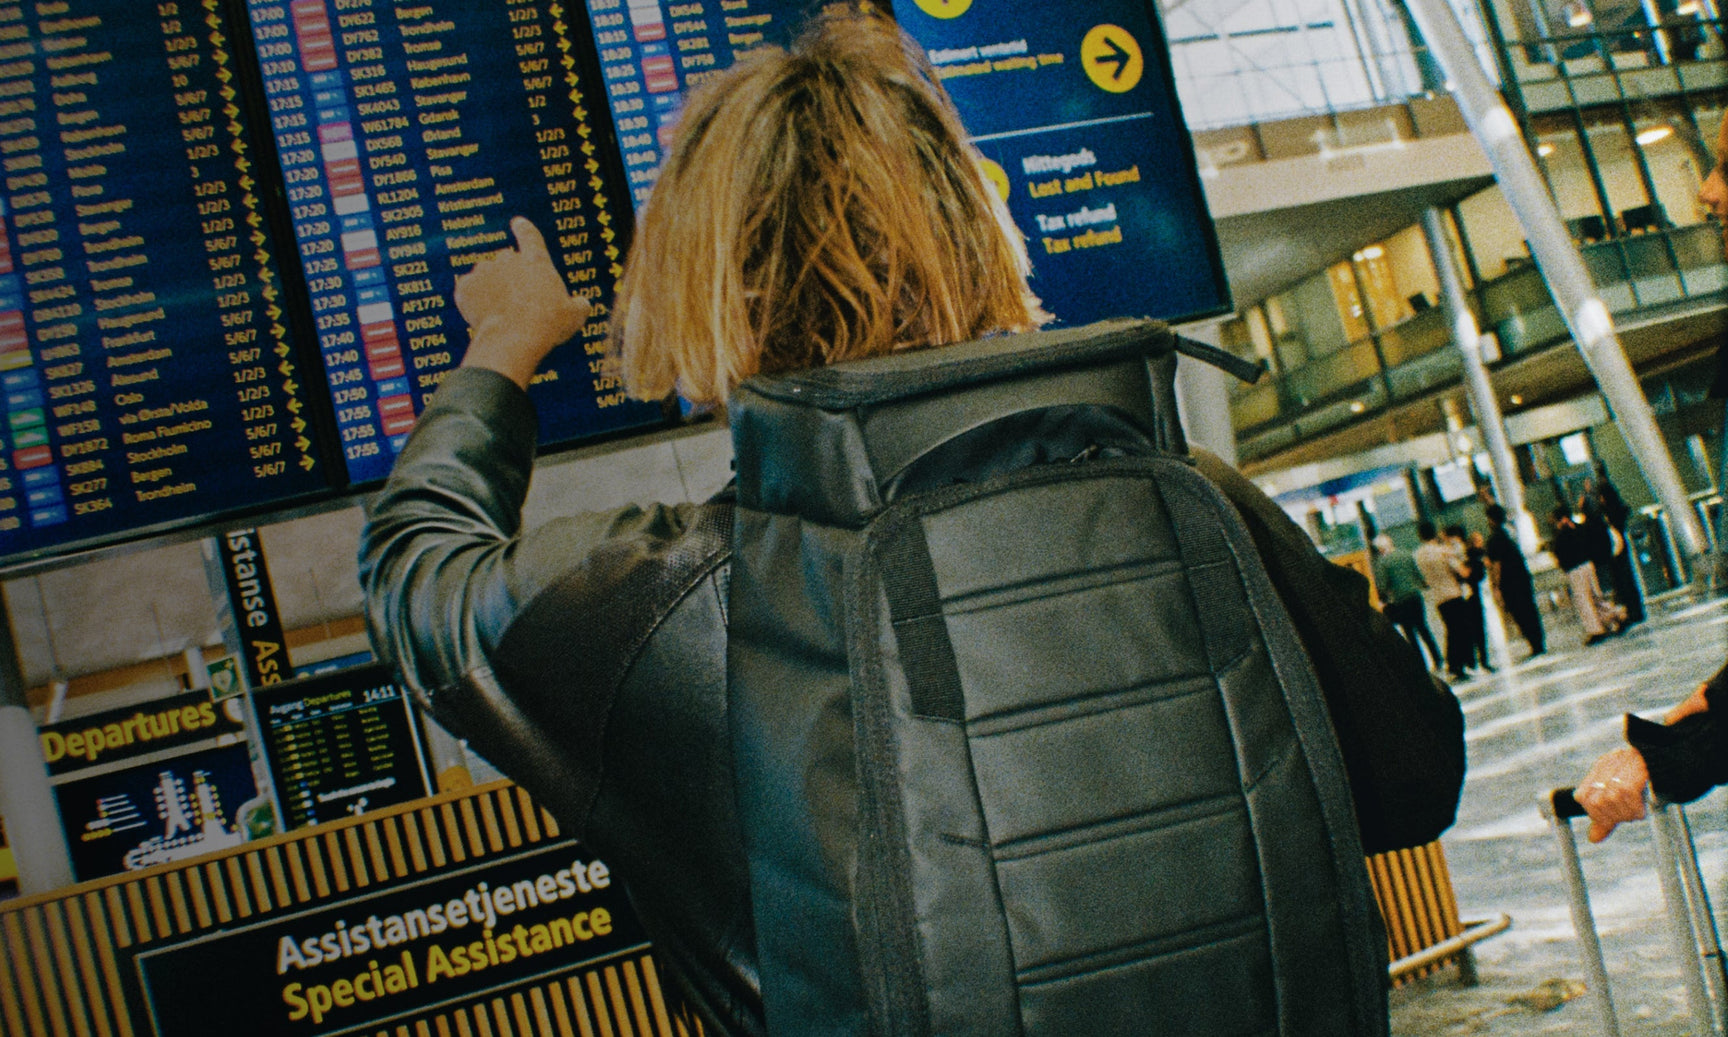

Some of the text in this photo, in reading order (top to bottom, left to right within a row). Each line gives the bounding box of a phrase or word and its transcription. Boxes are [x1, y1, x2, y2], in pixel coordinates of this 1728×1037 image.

[266, 78, 299, 93] 17:15
[270, 95, 302, 111] 17:15
[274, 113, 306, 129] 17:15
[278, 131, 310, 147] 17:15
[282, 149, 314, 165] 17:20
[285, 167, 318, 183] 17:20
[198, 199, 230, 214] 1/2/3
[297, 221, 330, 237] 17:20
[547, 180, 576, 195] 5/6/7
[202, 218, 233, 233] 1/2/3
[301, 239, 334, 255] 17:20
[552, 198, 581, 212] 1/2/3
[205, 236, 236, 251] 5/6/7
[305, 258, 337, 274] 17:25
[556, 216, 585, 230] 1/2/3
[209, 255, 240, 270] 5/6/7
[213, 273, 245, 289] 1/2/3
[309, 276, 341, 292] 17:30
[217, 292, 249, 307] 1/2/3
[313, 294, 346, 311] 17:30
[221, 311, 252, 326] 5/6/7
[317, 313, 350, 329] 17:35
[403, 295, 444, 313] AF1775
[225, 329, 256, 345] 5/6/7
[321, 331, 354, 347] 17:40
[229, 348, 260, 364] 5/6/7
[326, 350, 358, 366] 17:40
[234, 367, 265, 382] 1/2/3
[330, 368, 362, 385] 17:45
[238, 386, 269, 402] 1/2/3
[334, 387, 366, 404] 17:50
[242, 405, 274, 421] 1/2/3
[339, 406, 371, 422] 17:55
[343, 424, 375, 441] 17:55
[127, 445, 187, 463] Stockholm
[246, 424, 276, 440] 5/6/7
[250, 443, 281, 458] 5/6/7
[347, 442, 379, 459] 17:55
[136, 483, 195, 501] Trondheim
[254, 461, 285, 477] 5/6/7
[41, 701, 217, 764] Departures
[276, 857, 611, 975] Assistansetjeneste
[282, 906, 613, 1024] Special Assistance
